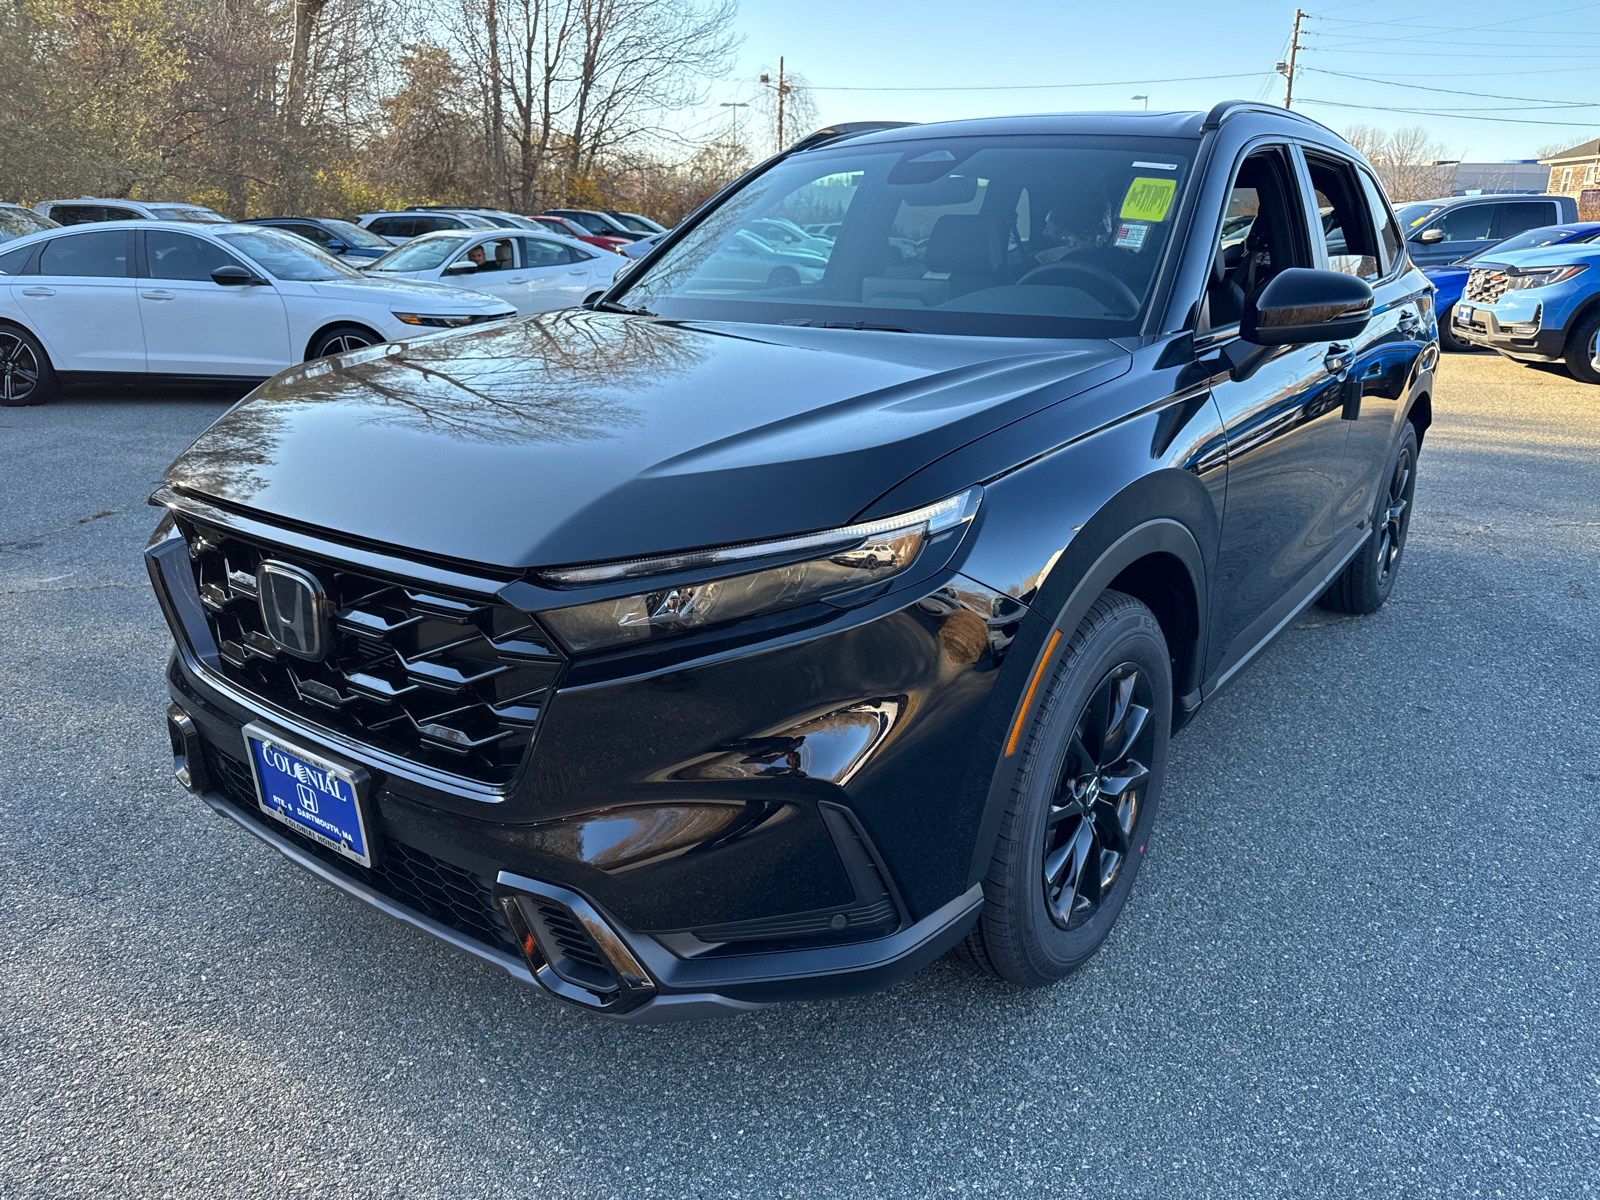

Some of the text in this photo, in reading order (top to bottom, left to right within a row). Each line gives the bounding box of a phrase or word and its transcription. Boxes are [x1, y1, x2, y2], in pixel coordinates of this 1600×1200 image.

[262, 745, 346, 802] COLONIAL
[285, 818, 343, 853] COLONIAL HONDA
[297, 807, 342, 837] DARTMOUTH,
[342, 830, 354, 842] MA
